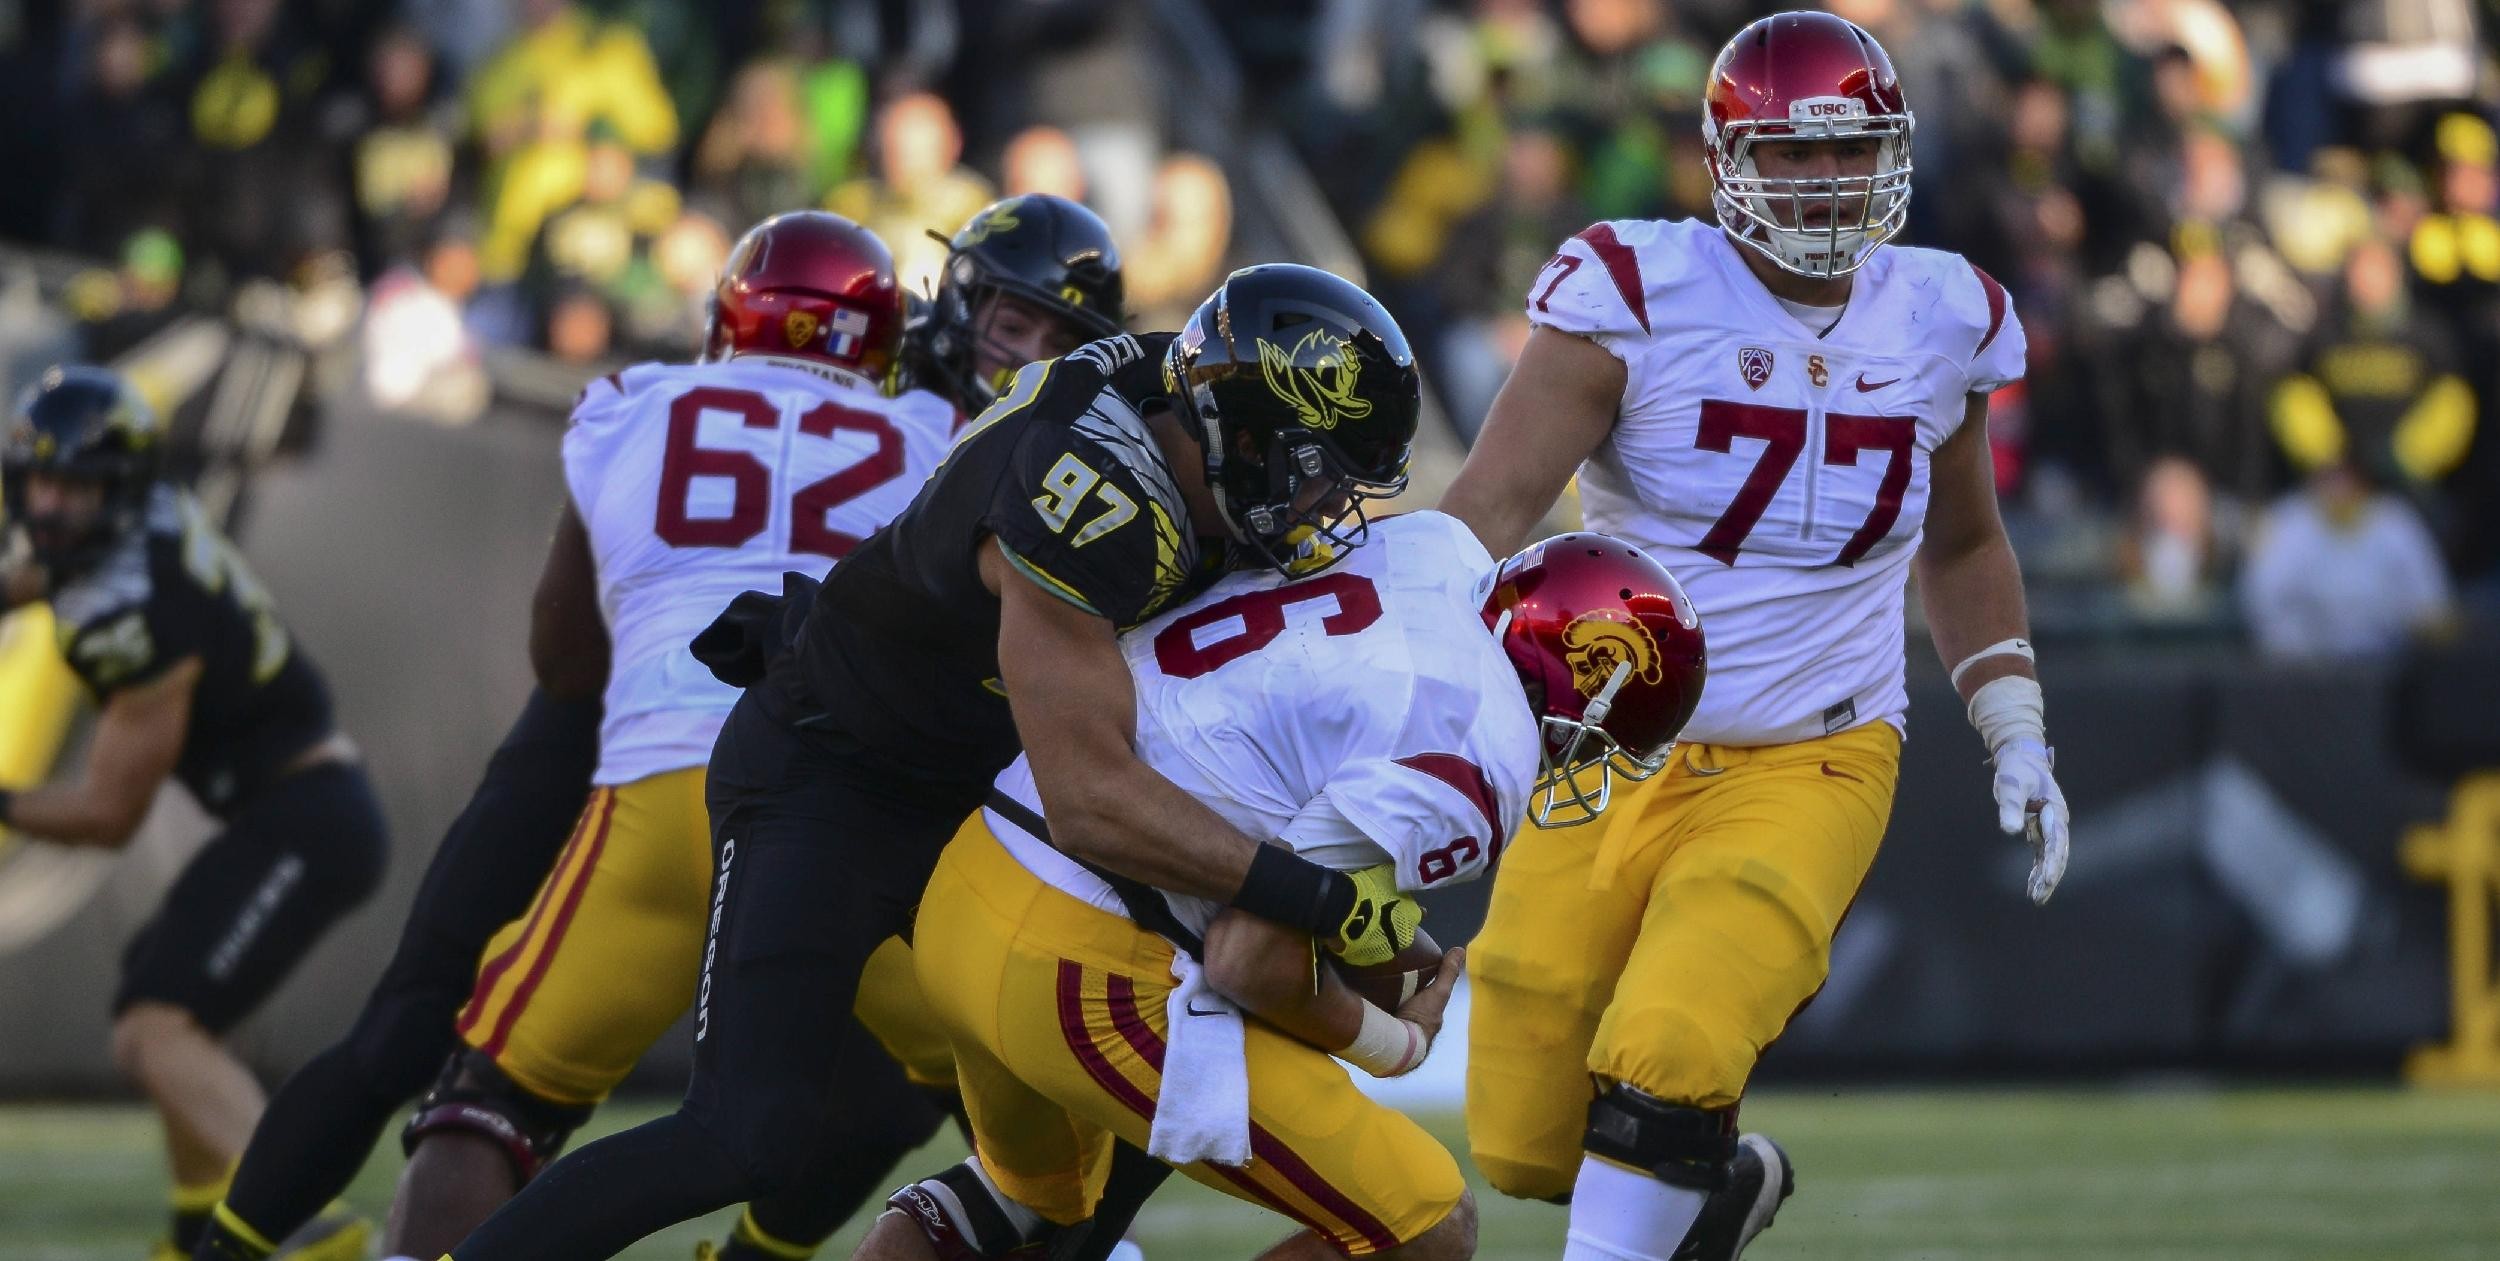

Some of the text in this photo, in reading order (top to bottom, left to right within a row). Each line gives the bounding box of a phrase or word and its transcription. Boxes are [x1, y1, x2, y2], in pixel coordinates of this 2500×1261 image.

[1808, 104, 1847, 116] USC
[1807, 355, 1829, 387] SC
[654, 386, 906, 562] 62
[1032, 452, 1139, 548] 97
[1694, 398, 1919, 568] 77
[1153, 571, 1384, 680] 6
[1417, 835, 1480, 884] 6
[697, 838, 736, 1042] OREGON
